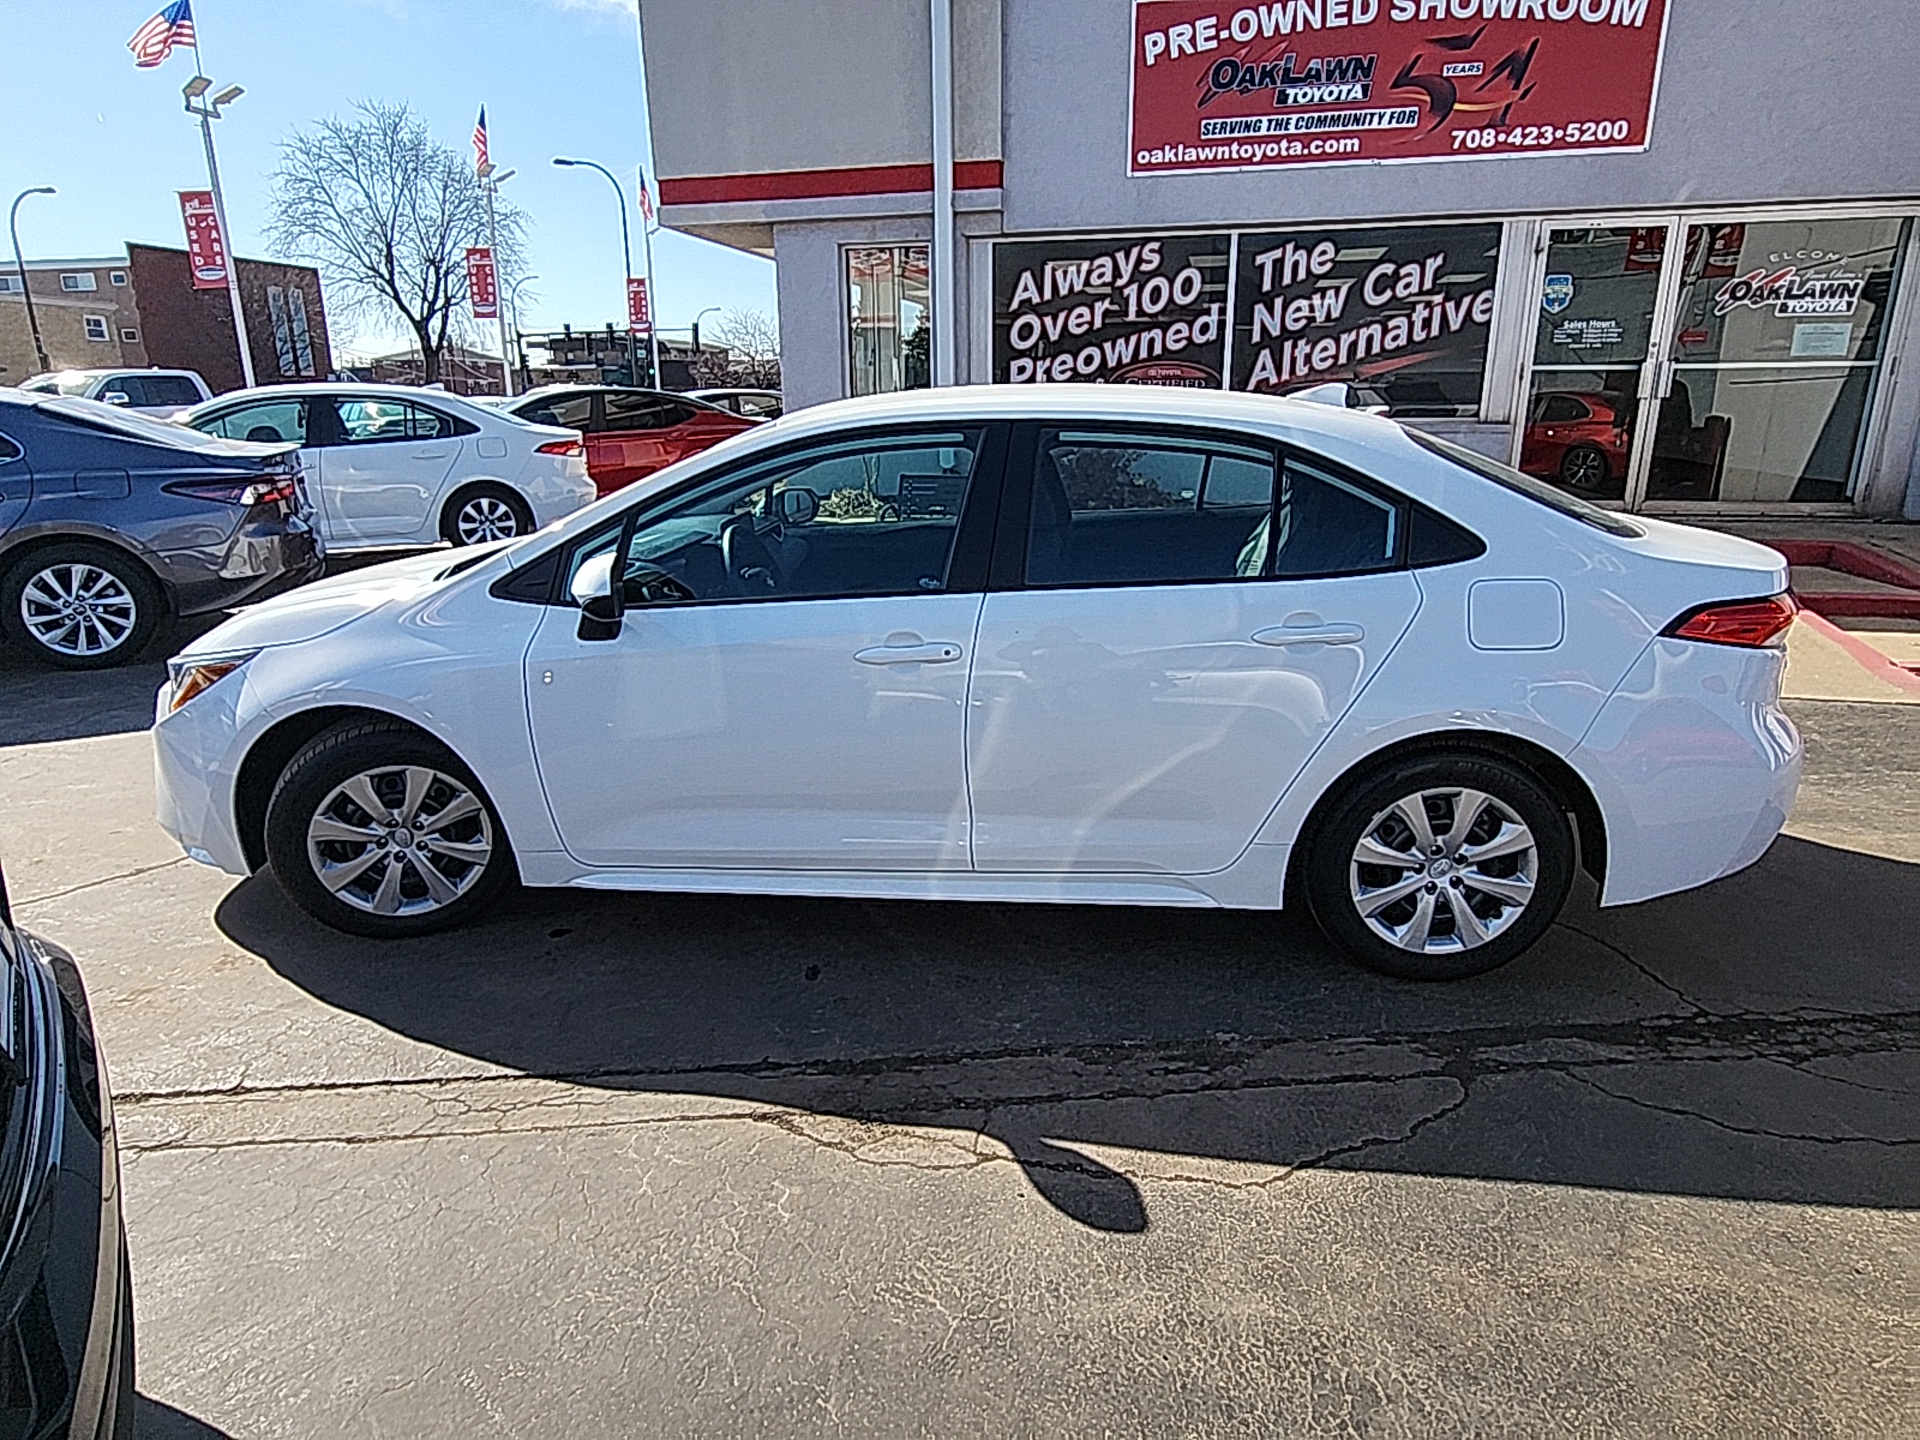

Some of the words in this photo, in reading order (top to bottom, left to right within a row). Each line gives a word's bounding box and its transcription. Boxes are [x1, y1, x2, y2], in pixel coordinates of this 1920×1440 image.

[1144, 0, 1378, 65] PRE-OWNED
[1389, 0, 1651, 27] SHOWROOM
[1286, 84, 1364, 103] TOYOTA
[1445, 64, 1482, 74] YEARS
[1202, 119, 1262, 137] SERVING
[1265, 115, 1292, 133] THE
[1294, 111, 1386, 131] COMMUNITY
[1388, 109, 1418, 125] FOR
[1136, 136, 1361, 164] oaklawntoyota.com
[187, 216, 205, 266] USED
[207, 216, 223, 265] CARS
[1008, 241, 1162, 313] Always
[1254, 240, 1336, 293] The
[1010, 297, 1112, 350] Over
[1122, 266, 1203, 322] 100
[1251, 282, 1352, 344] New
[1363, 252, 1446, 306] Car
[1787, 301, 1848, 313] TOYOTA
[1010, 302, 1221, 383] Preowned
[1246, 289, 1494, 391] Alternative
[1563, 320, 1587, 329] Sales
[1589, 320, 1616, 328] Hours
